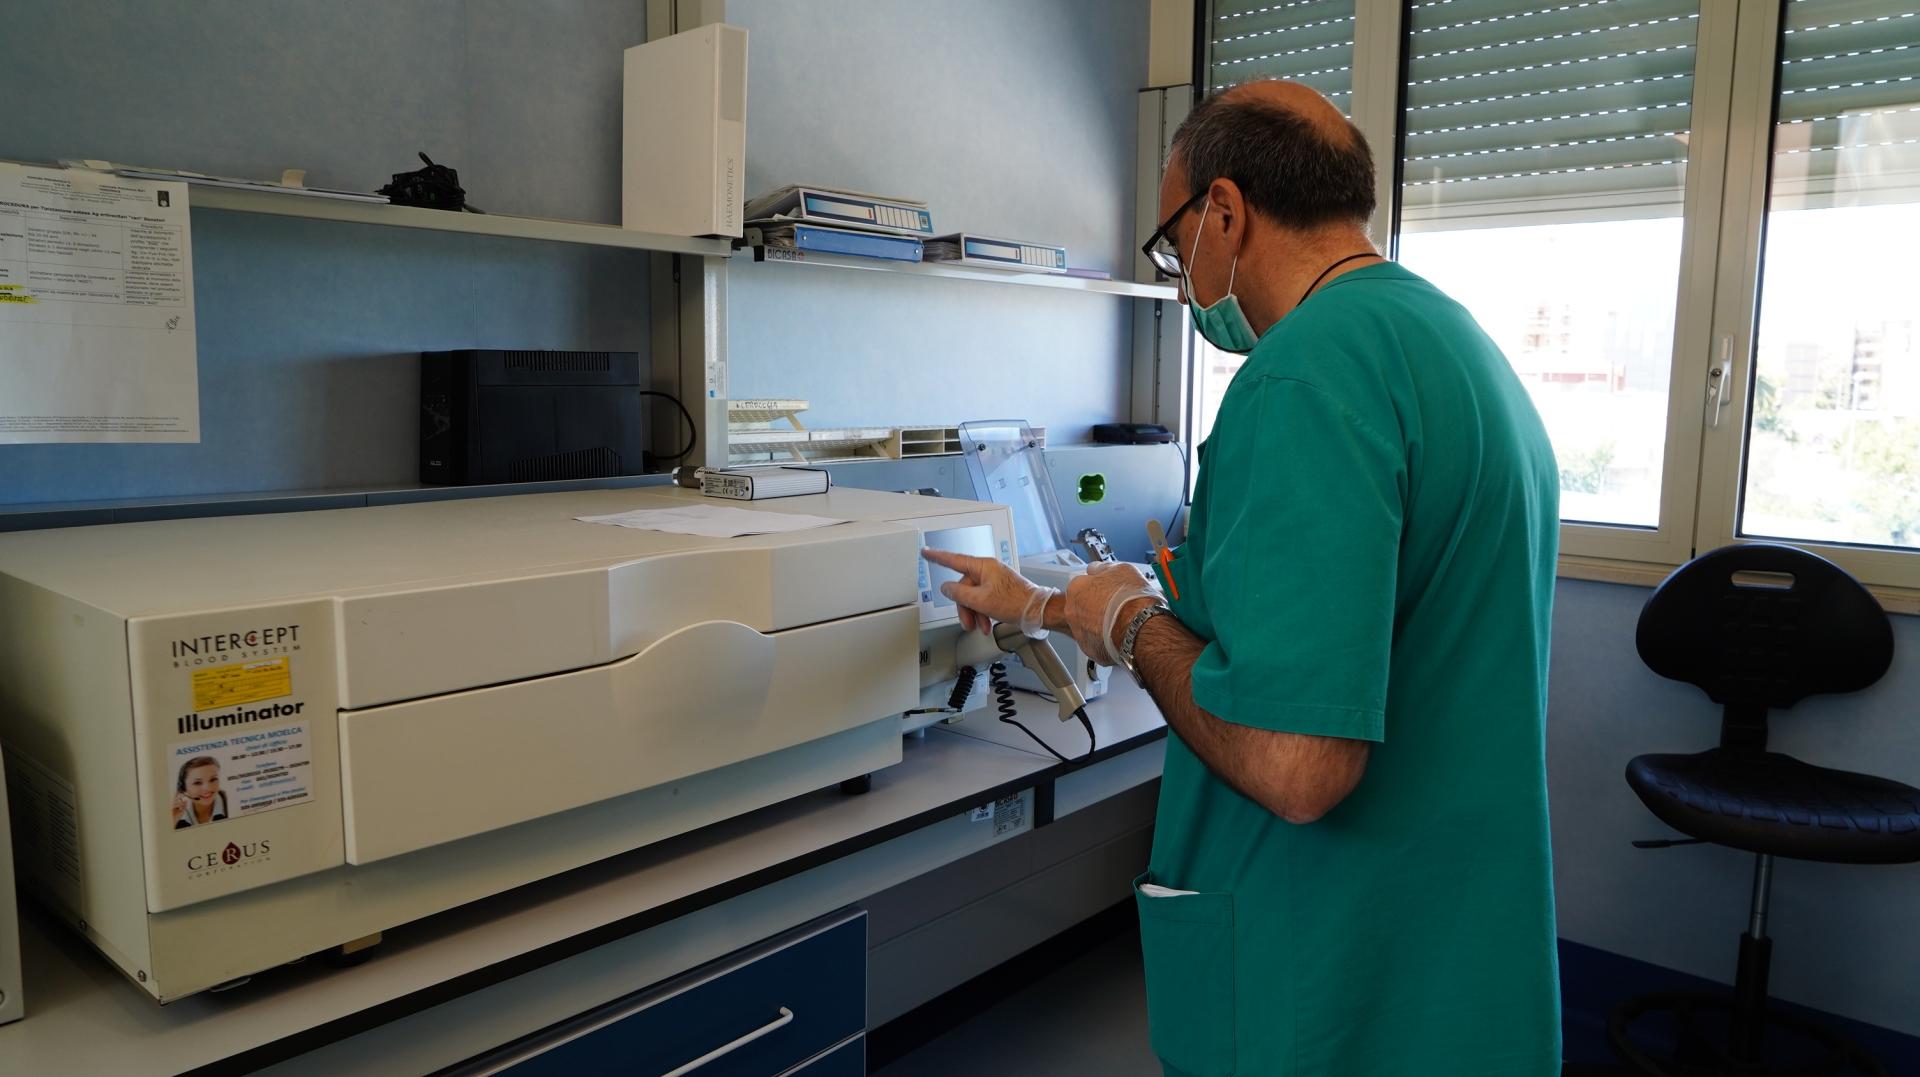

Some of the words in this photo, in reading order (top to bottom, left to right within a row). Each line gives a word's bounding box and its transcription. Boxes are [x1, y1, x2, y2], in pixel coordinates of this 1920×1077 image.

[725, 157, 735, 228] HAEMONETICS
[172, 625, 300, 658] INTERCEPT
[173, 655, 229, 668] BLOOD
[241, 645, 301, 659] SYSTEM
[178, 702, 304, 734] Illuminator
[176, 740, 228, 755] ASSISTENZA
[230, 733, 266, 746] TECNICA
[187, 840, 271, 871] CERUS
